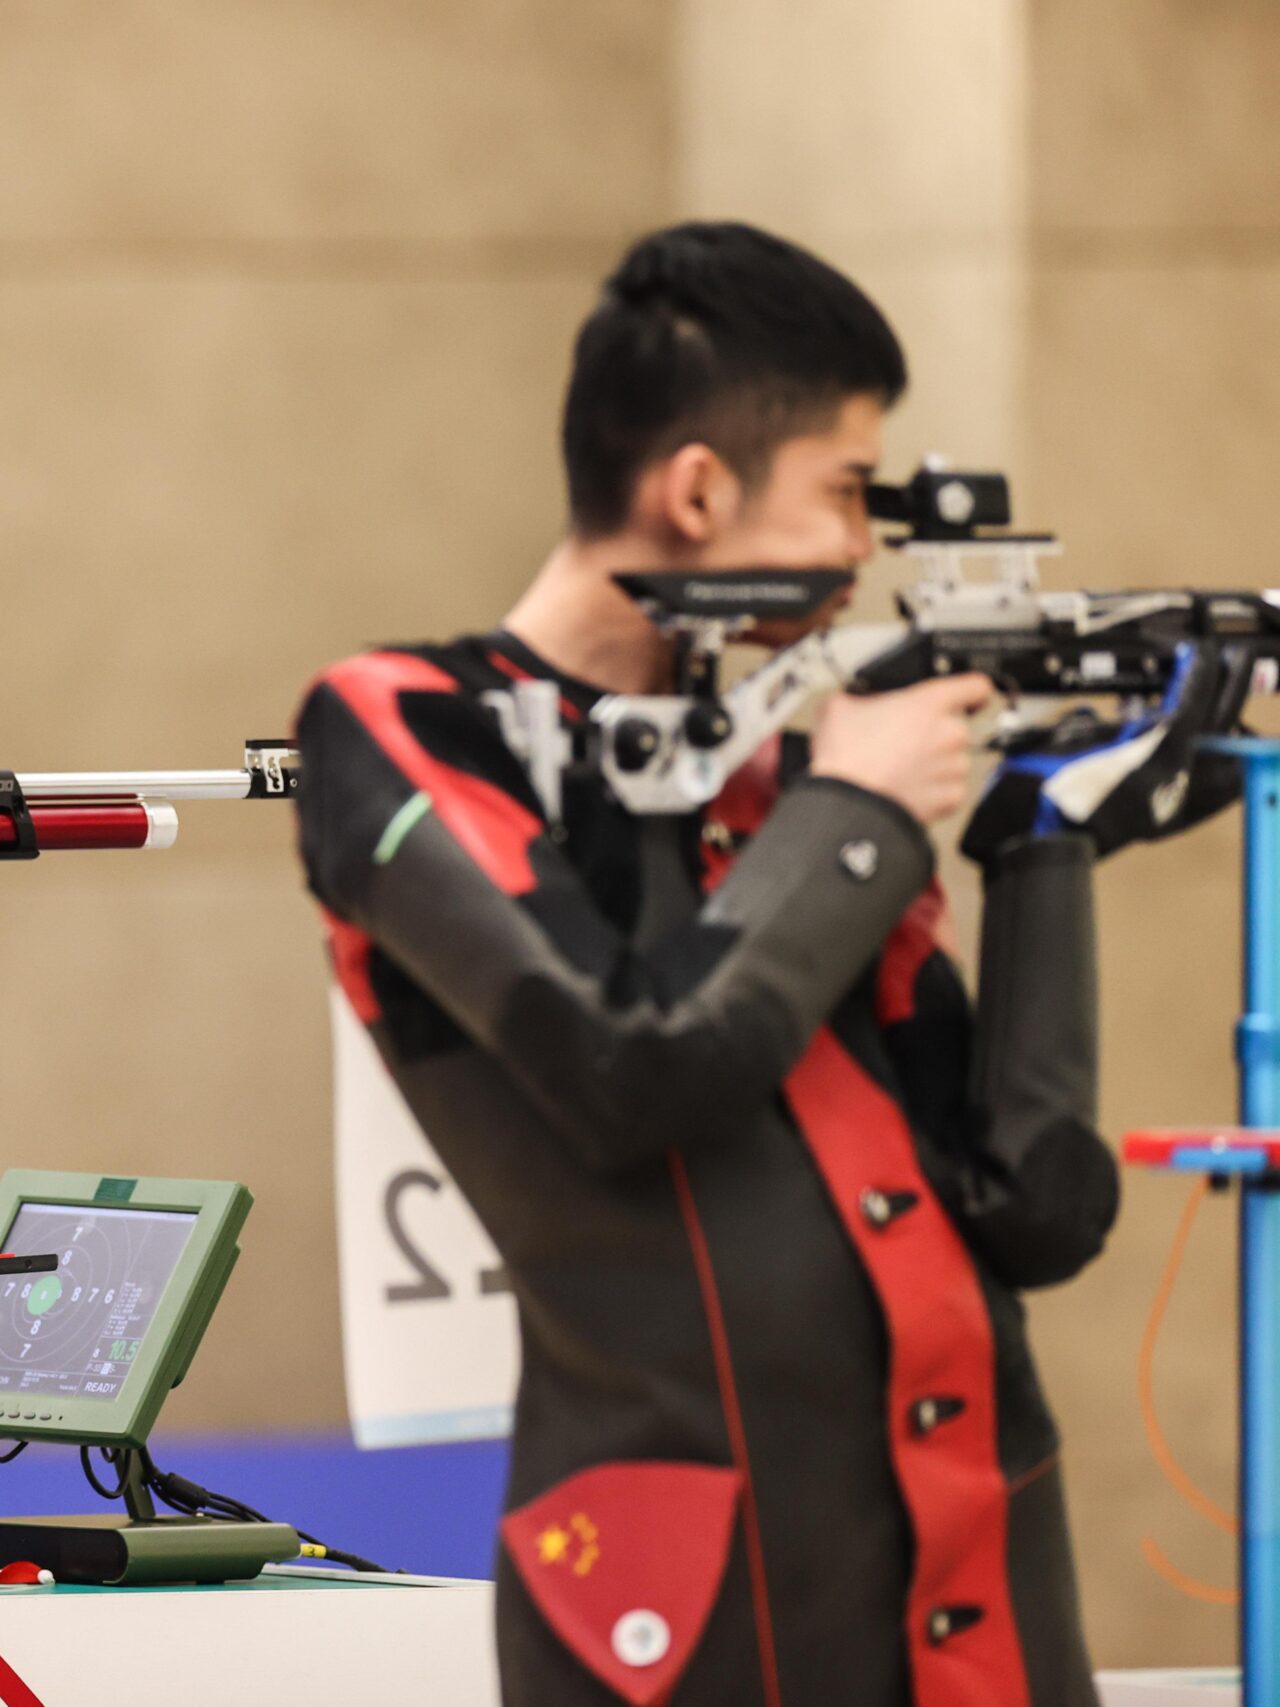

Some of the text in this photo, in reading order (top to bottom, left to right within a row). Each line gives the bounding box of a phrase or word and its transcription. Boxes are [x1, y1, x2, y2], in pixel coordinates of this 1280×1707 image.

[73, 1226, 83, 1242] 7
[61, 1250, 72, 1266] 8
[4, 1282, 16, 1297] 7
[21, 1283, 32, 1299] 8
[71, 1287, 82, 1302] 8
[88, 1288, 100, 1303] 7
[104, 1289, 115, 1304] 6
[30, 1319, 41, 1335] 8
[20, 1343, 32, 1359] 7
[108, 1340, 140, 1361] 10.5
[84, 1382, 117, 1393] READY
